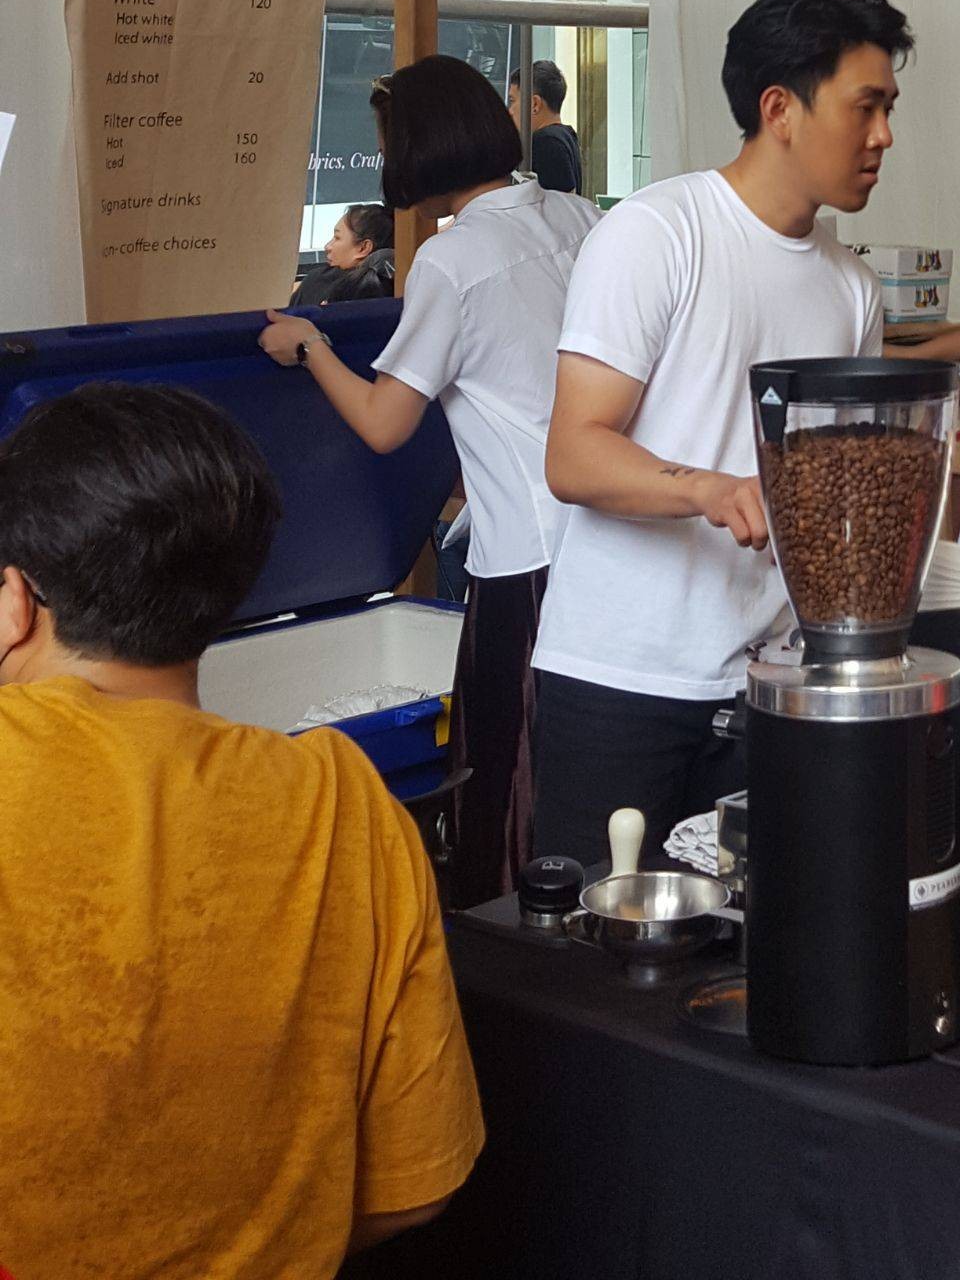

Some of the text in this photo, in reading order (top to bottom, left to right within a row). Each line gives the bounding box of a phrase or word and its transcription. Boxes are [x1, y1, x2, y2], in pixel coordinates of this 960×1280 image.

[116, 12, 174, 26] Hot white
[114, 31, 174, 45] Iced white
[106, 71, 264, 85] Add shot 20
[104, 111, 183, 129] Filter coffee
[106, 133, 258, 150] Hot 150
[234, 152, 257, 165] 160
[308, 152, 346, 171] brics,
[158, 193, 201, 207] drinks
[103, 236, 217, 258] on-coffee choices
